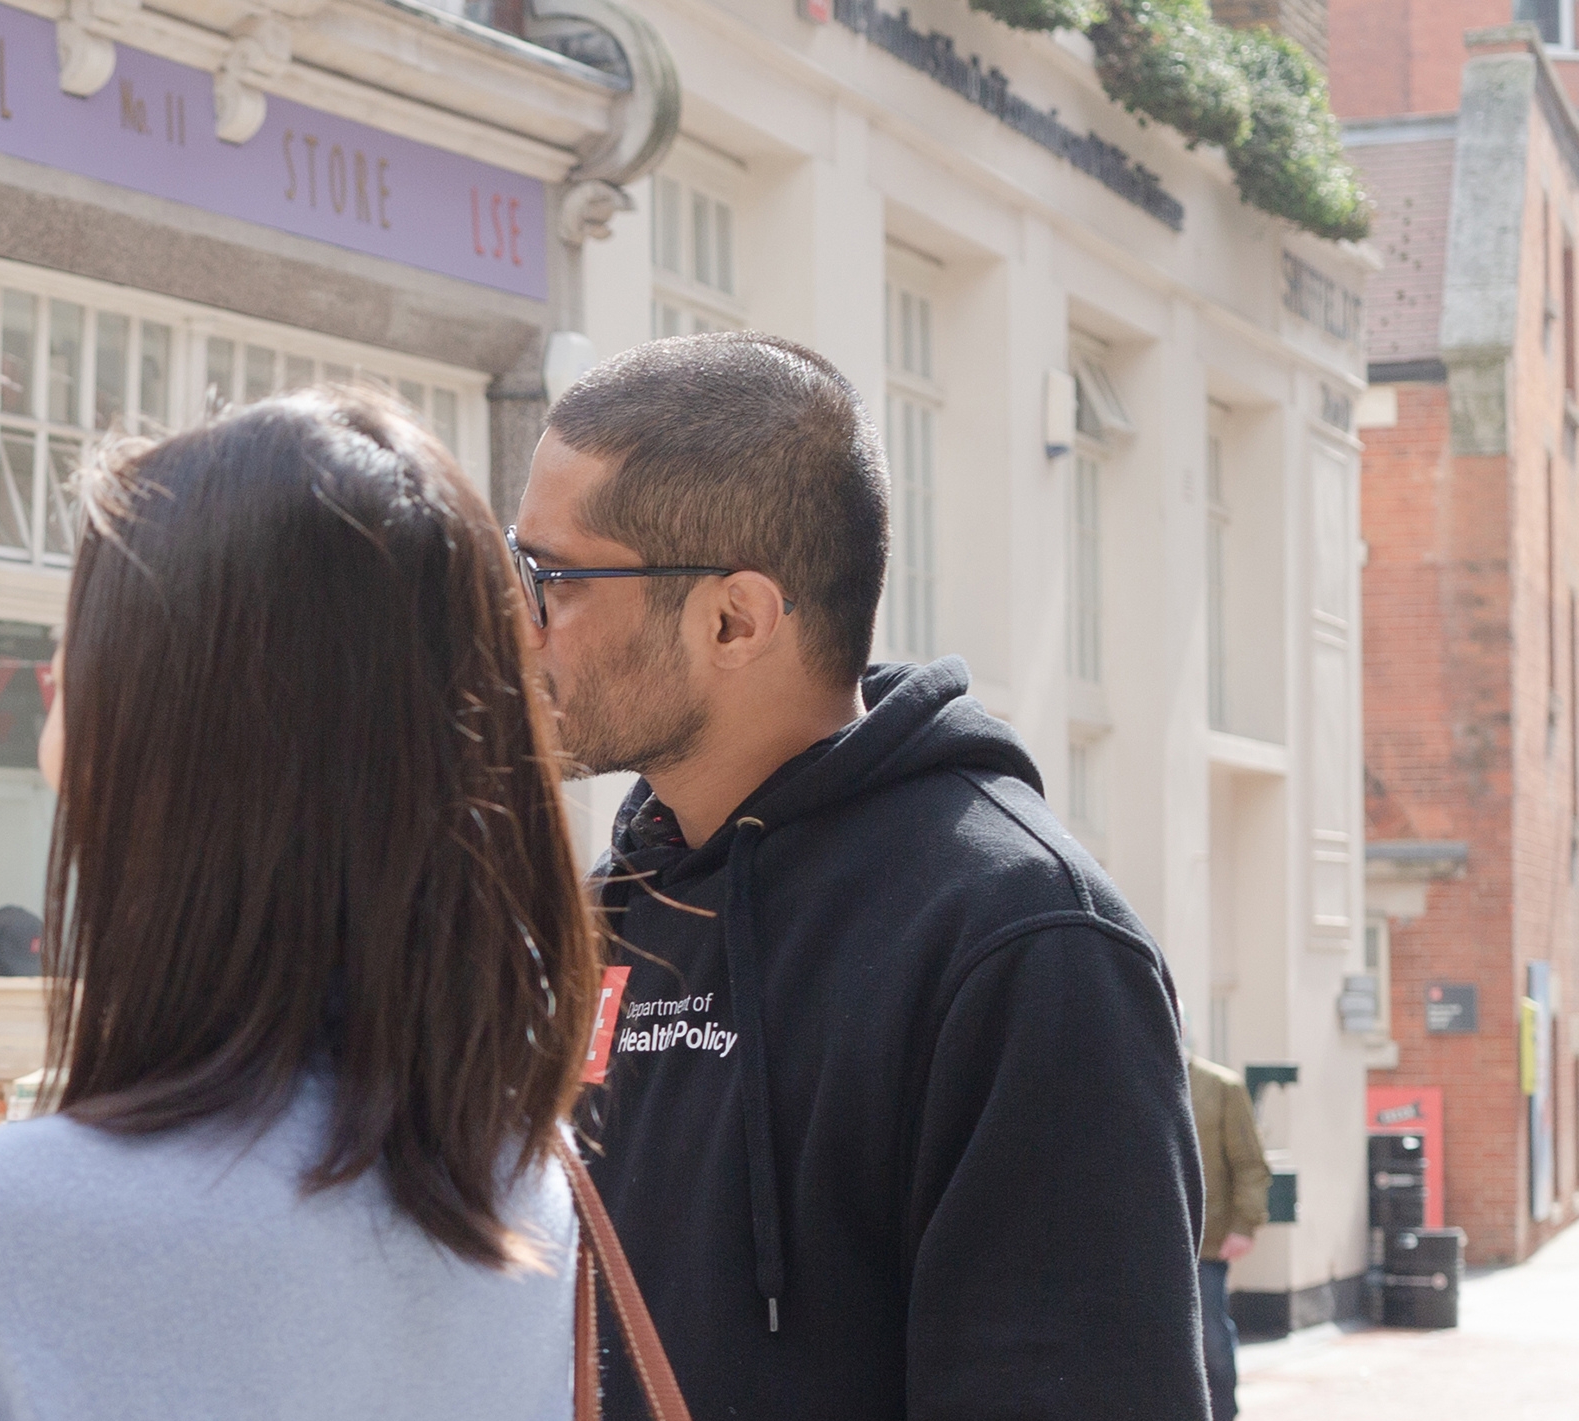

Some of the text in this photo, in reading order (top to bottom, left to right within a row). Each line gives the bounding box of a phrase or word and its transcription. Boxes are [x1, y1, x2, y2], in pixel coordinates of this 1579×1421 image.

[283, 129, 392, 230] STORE
[471, 187, 522, 266] LSE
[693, 992, 714, 1012] of
